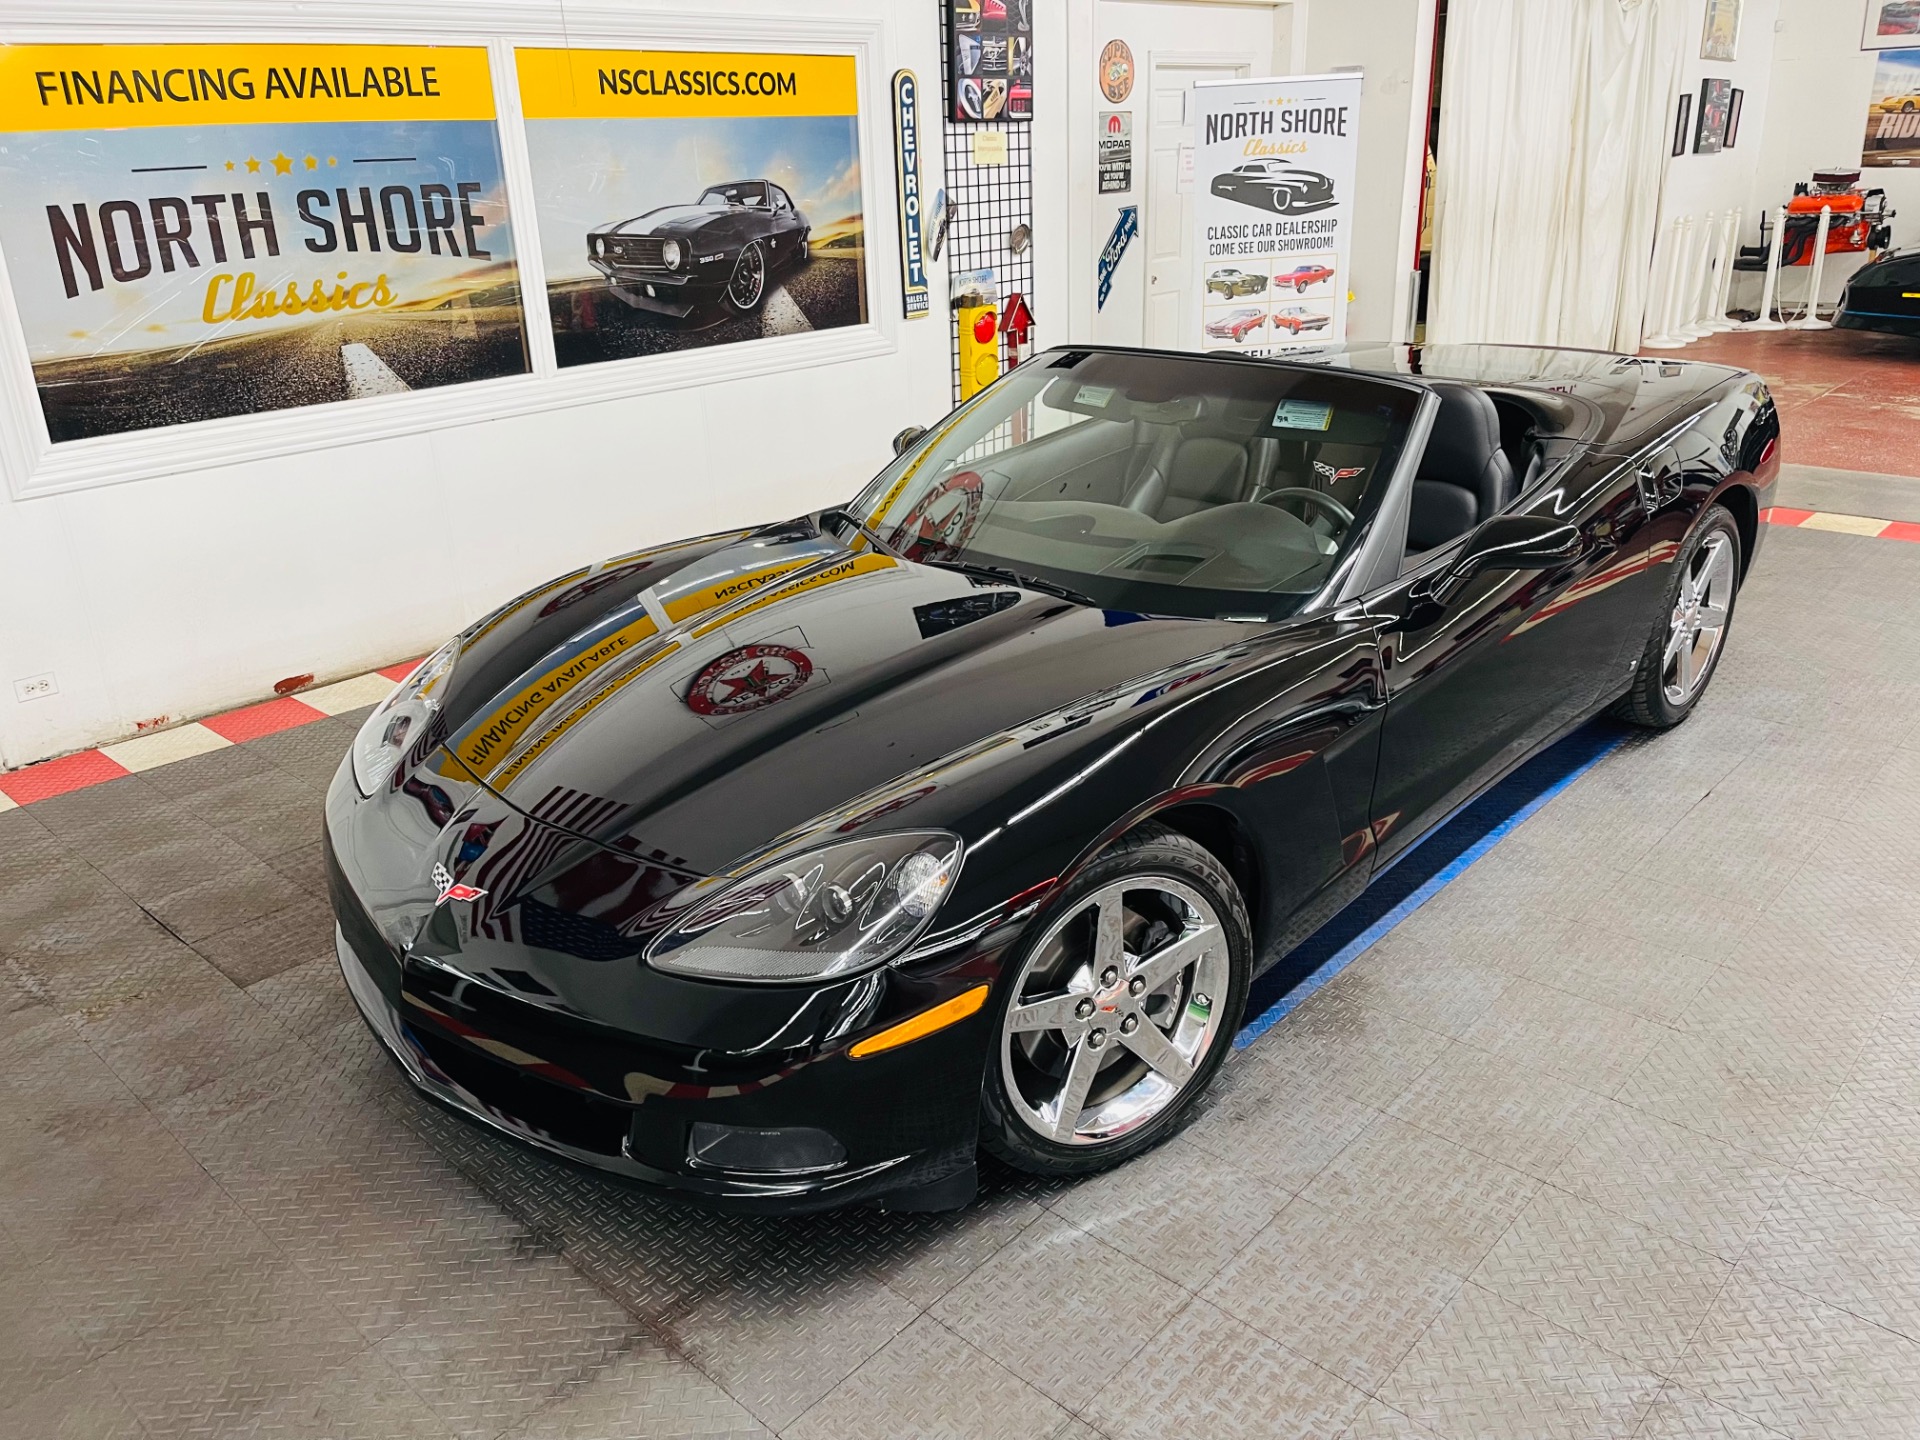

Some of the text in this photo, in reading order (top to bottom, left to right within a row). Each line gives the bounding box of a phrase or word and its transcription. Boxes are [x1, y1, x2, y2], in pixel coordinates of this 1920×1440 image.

[1102, 43, 1131, 68] SUPER
[36, 66, 440, 106] FINANCING AVAILABLE
[599, 69, 797, 96] NSCLASSICS.COM
[1108, 77, 1129, 99] BEE
[1206, 107, 1348, 145] NORTH SHORE
[1876, 113, 1920, 138] RID
[1099, 139, 1131, 150] MOPAR
[1243, 138, 1308, 156] Classics
[900, 83, 920, 282] CHEVROLET
[46, 183, 492, 299] NORTH SHORE
[1207, 219, 1338, 240] CLASSIC CAR DEALERSHIP
[1105, 228, 1128, 272] Ford
[1209, 236, 1334, 256] COME SEE OUR SHOWROOM!
[202, 271, 398, 325] Classics
[906, 295, 923, 303] SALES
